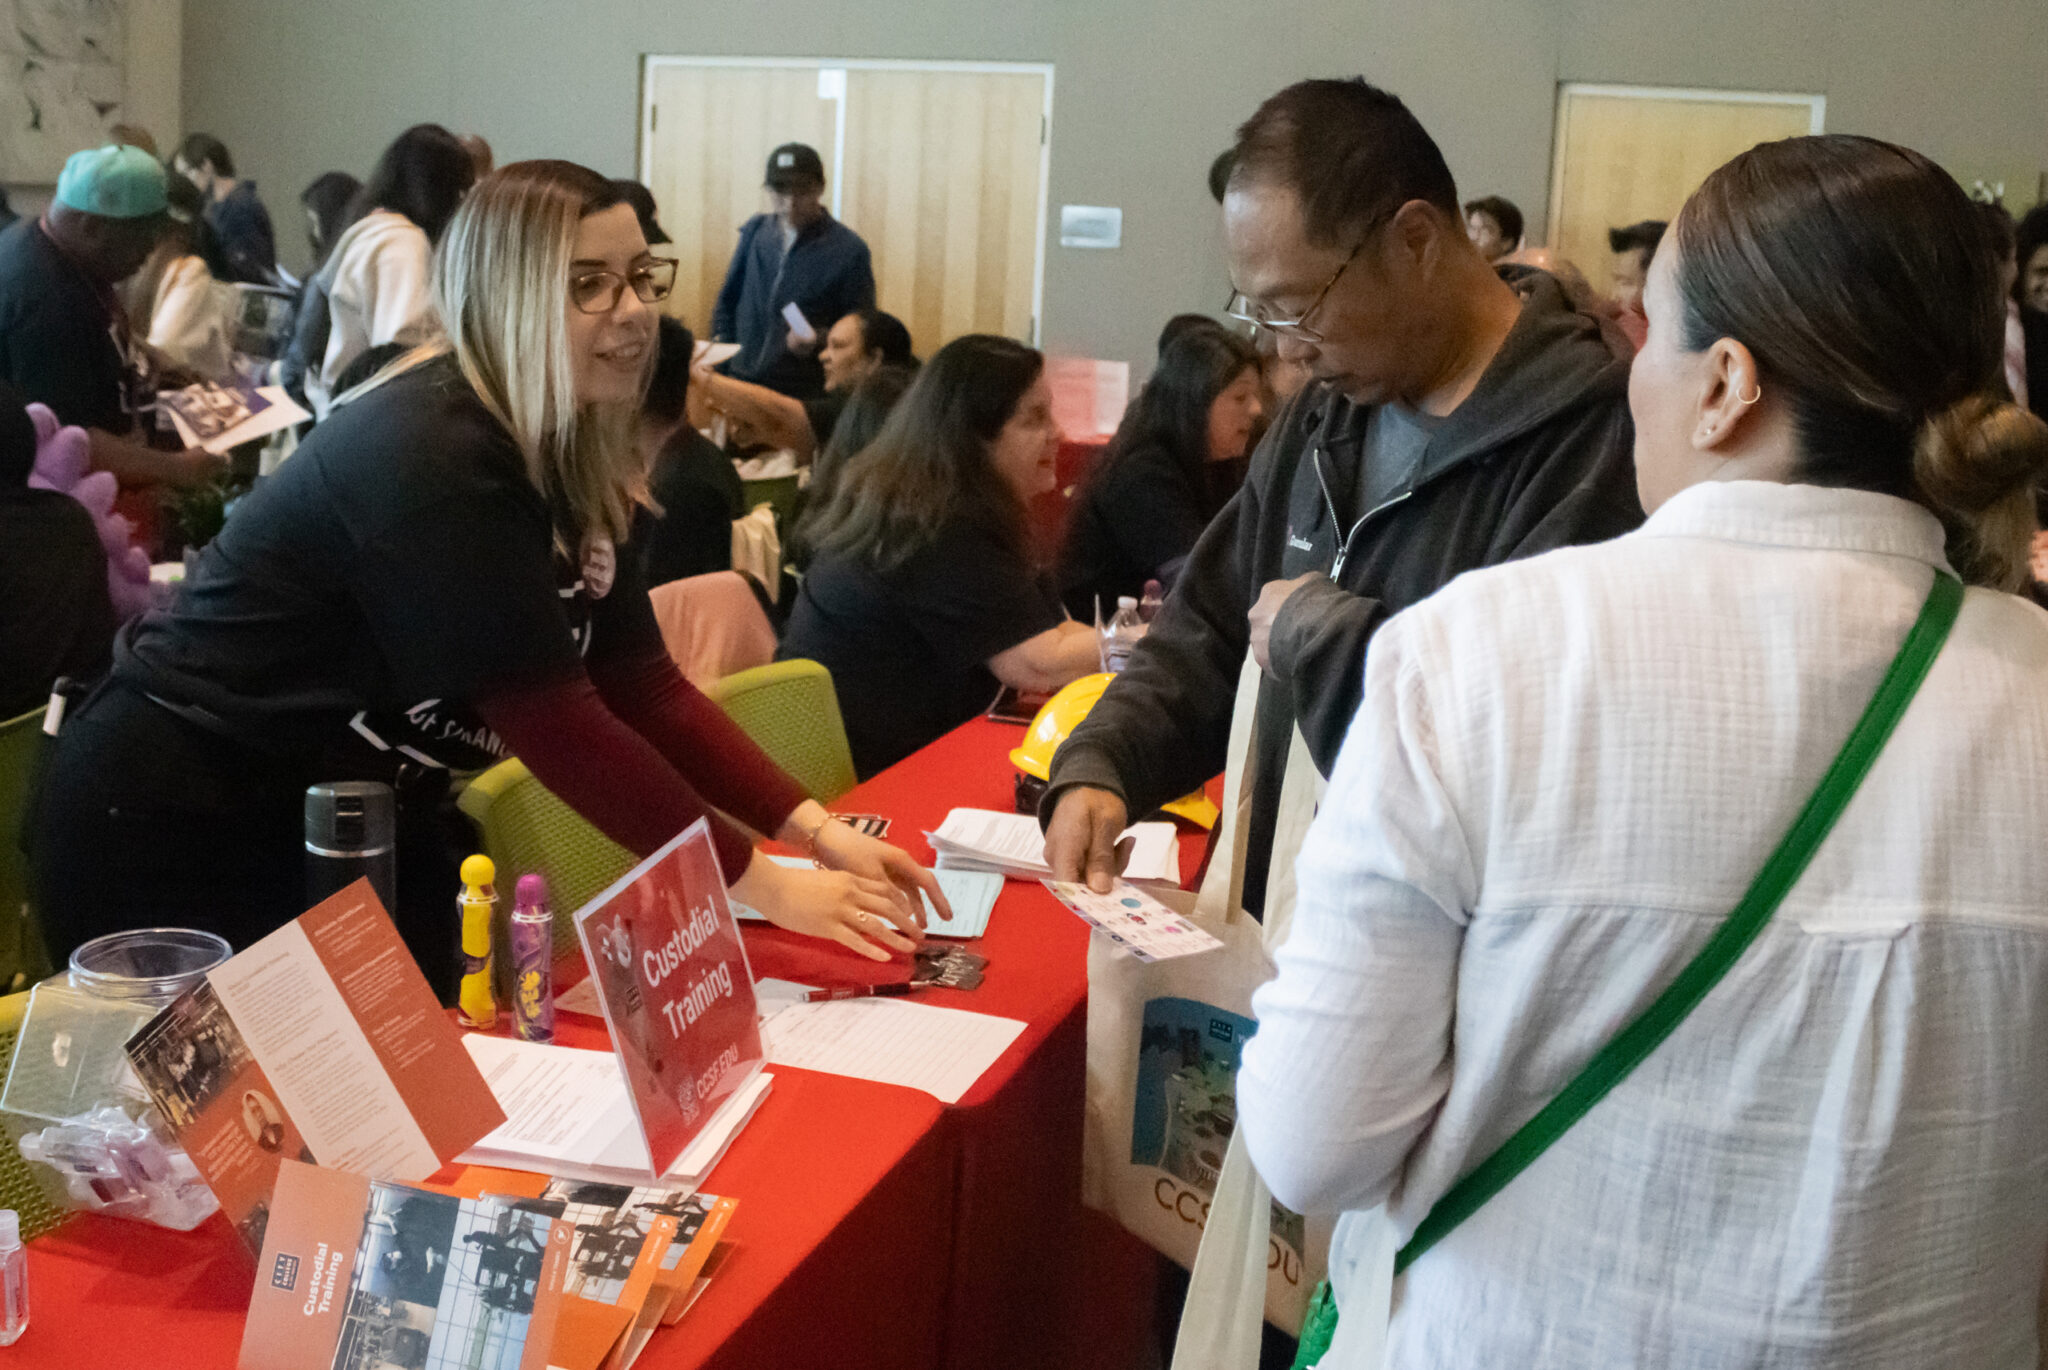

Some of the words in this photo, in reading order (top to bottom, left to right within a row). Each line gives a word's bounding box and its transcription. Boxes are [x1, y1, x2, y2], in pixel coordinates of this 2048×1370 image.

[642, 895, 720, 987] Custodial
[662, 961, 733, 1039] Training
[303, 1242, 329, 1316] Custodial
[318, 1251, 344, 1313] Training
